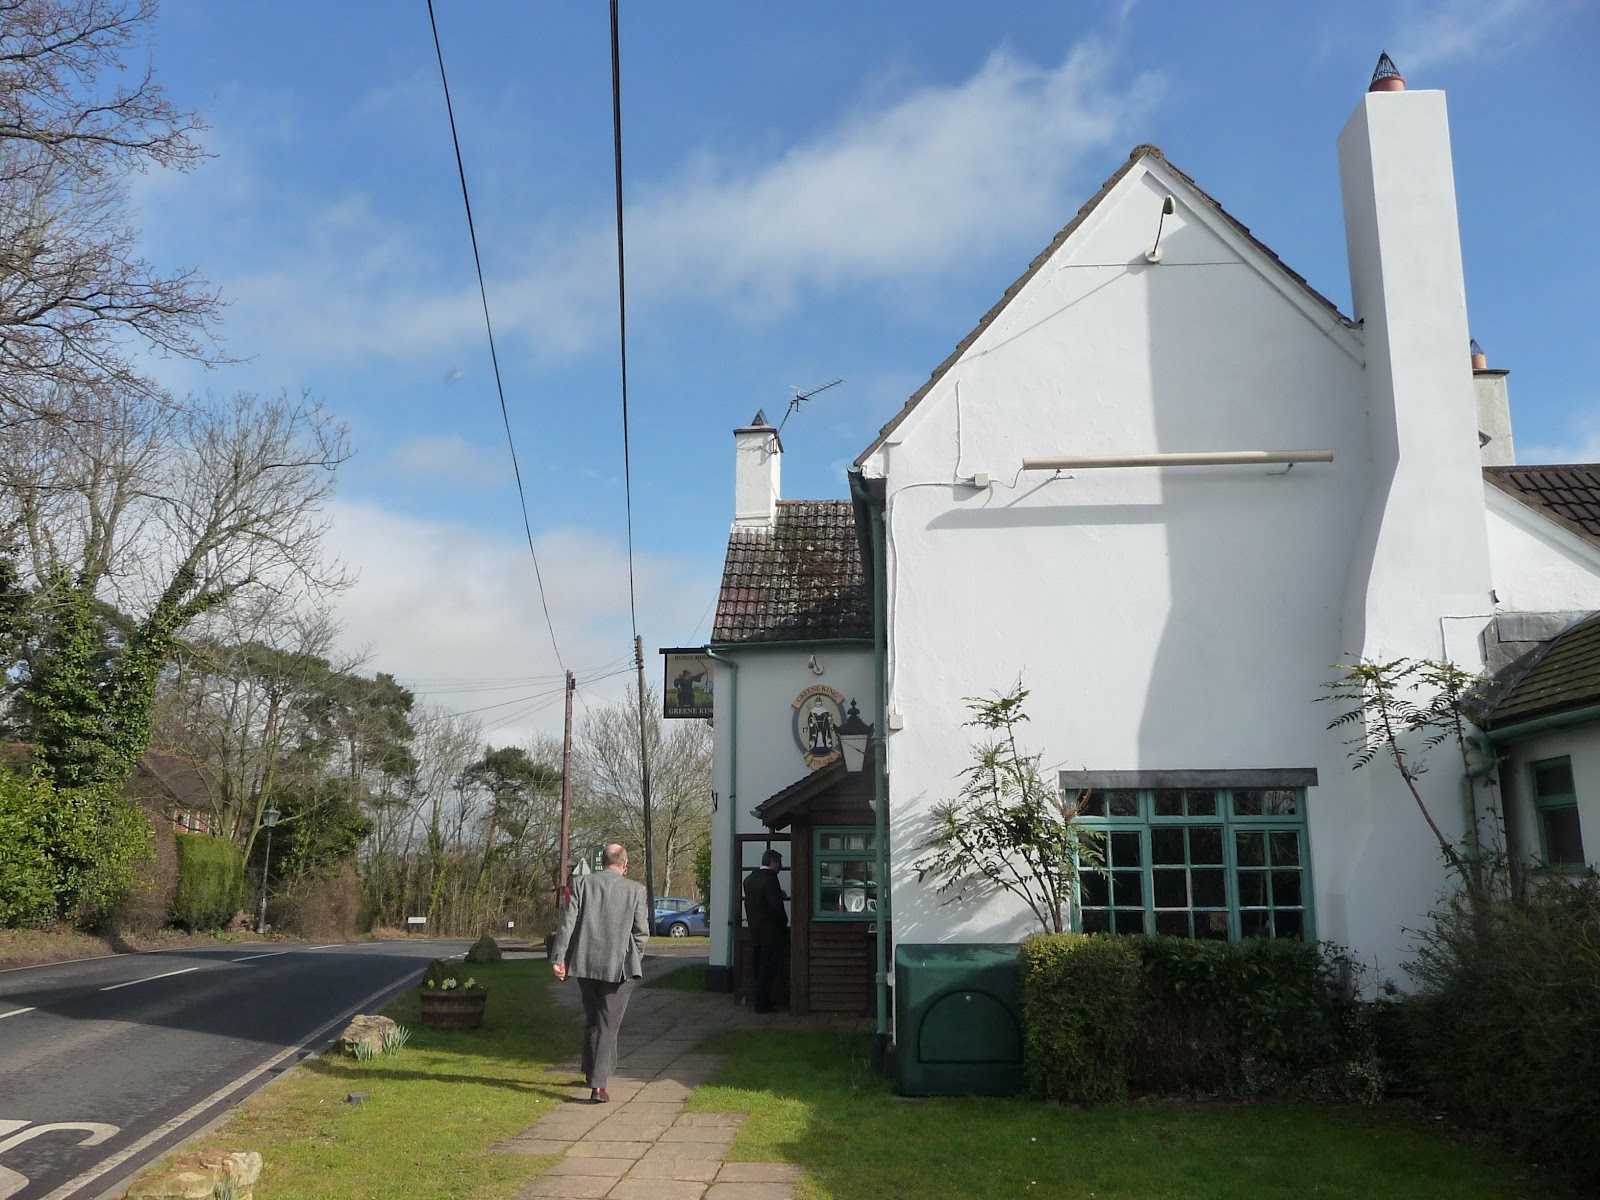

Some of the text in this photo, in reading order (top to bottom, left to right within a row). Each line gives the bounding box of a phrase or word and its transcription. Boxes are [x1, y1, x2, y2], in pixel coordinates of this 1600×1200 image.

[796, 685, 839, 703] GREENE KING
[668, 707, 714, 715] GREENE KIN
